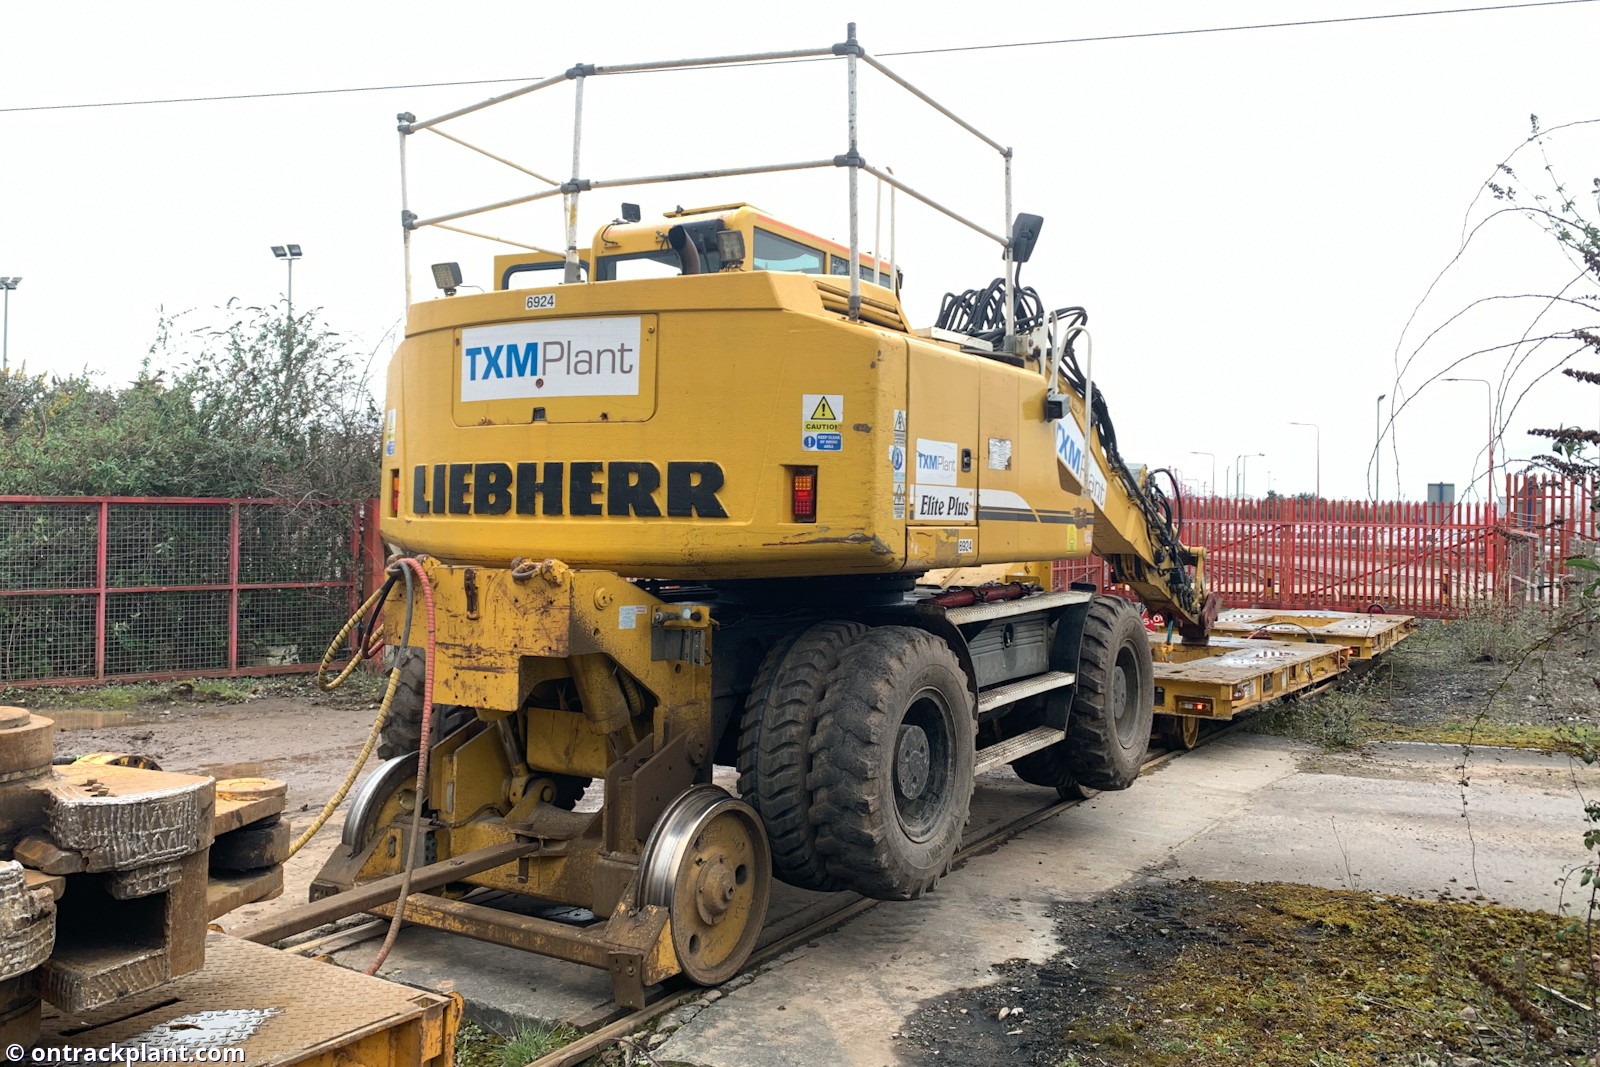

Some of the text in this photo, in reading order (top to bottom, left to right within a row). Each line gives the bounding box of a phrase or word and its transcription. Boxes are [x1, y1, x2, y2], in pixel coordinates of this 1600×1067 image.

[526, 295, 554, 309] 6924
[465, 340, 633, 381] TXMPlant
[918, 453, 956, 472] TXMPlant
[413, 461, 729, 519] LIEBHERR
[920, 494, 944, 516] Elite
[947, 496, 970, 516] Plus
[959, 540, 972, 552] 6924
